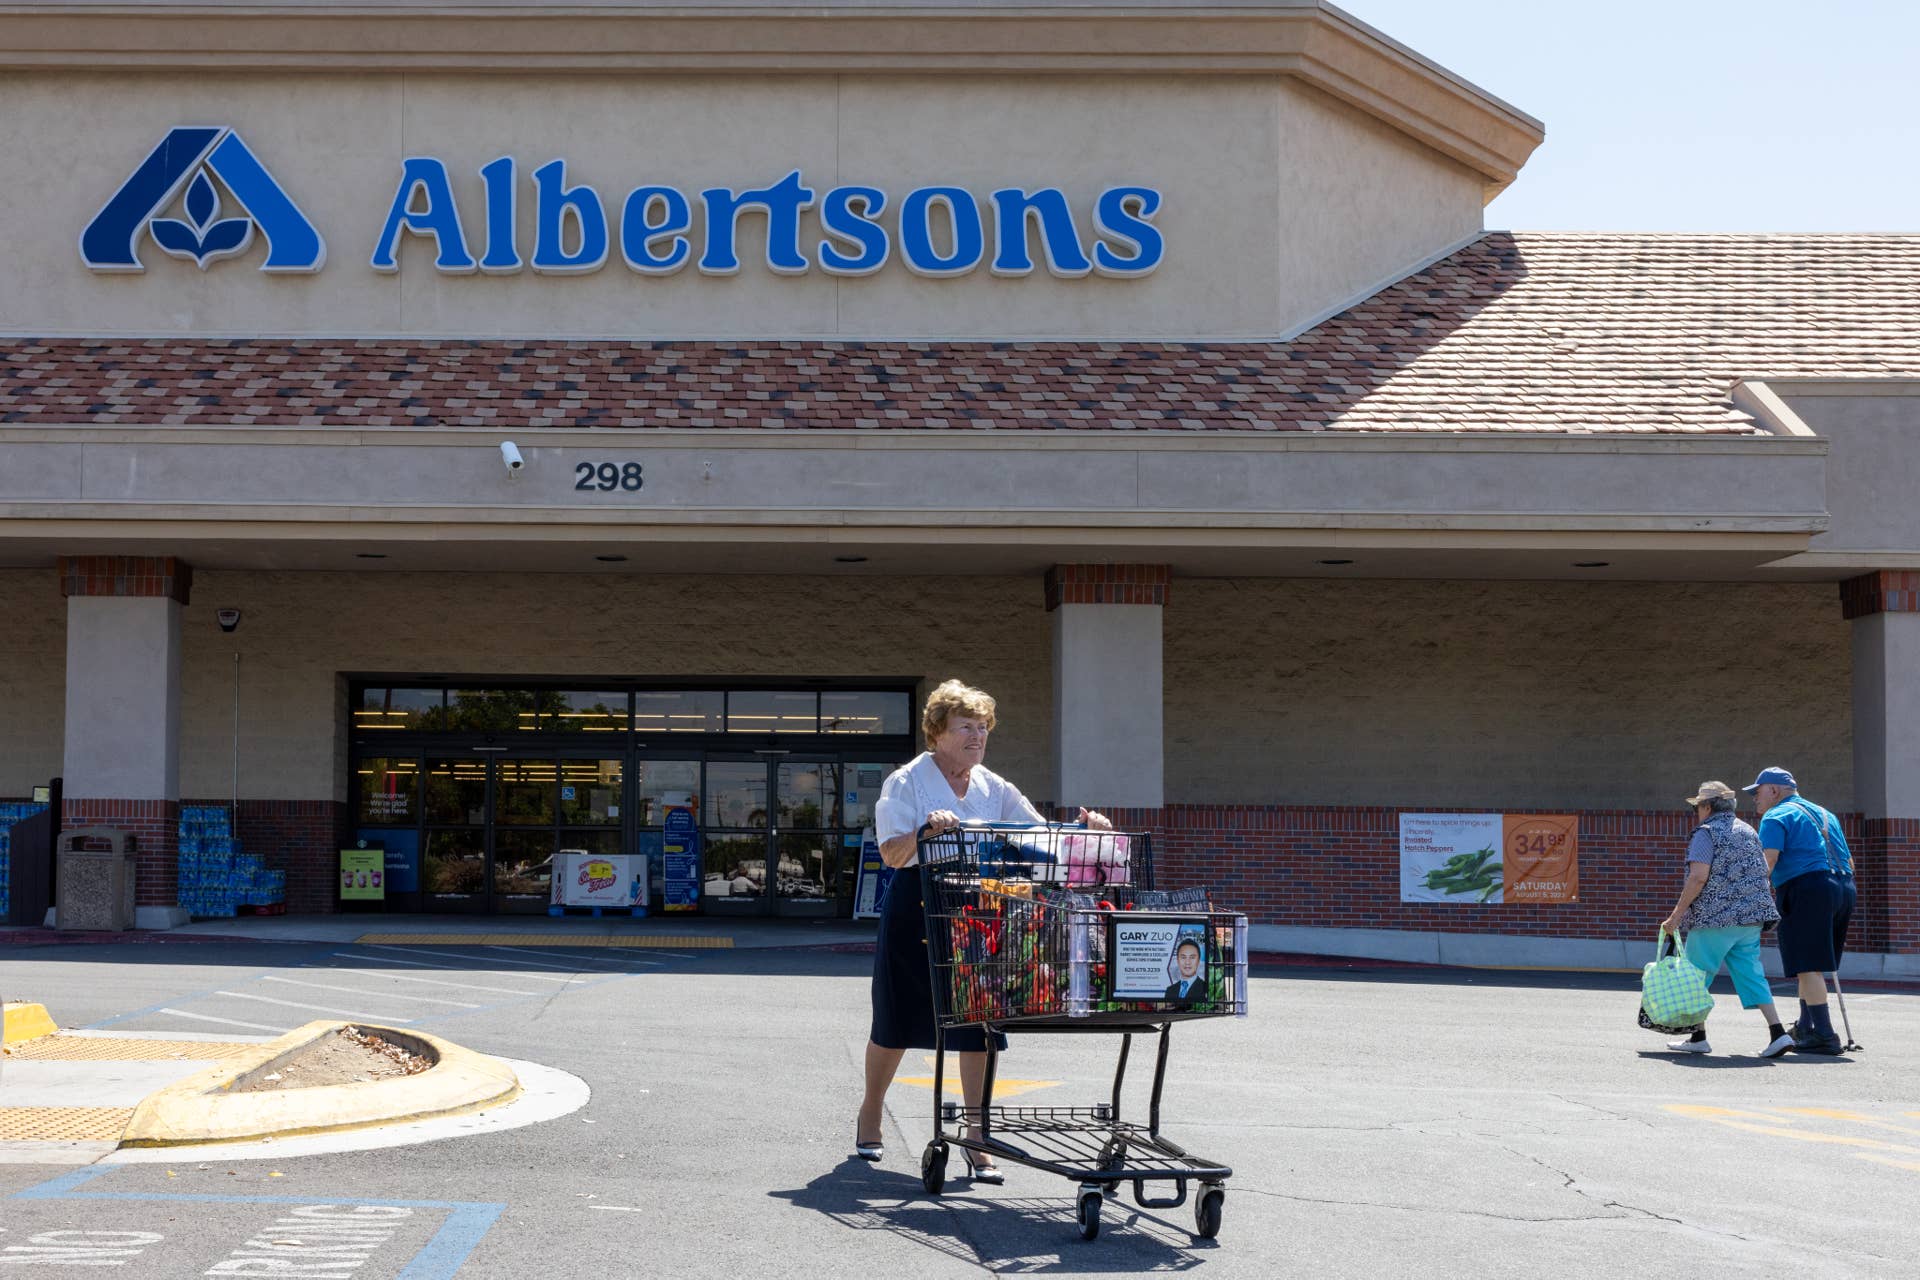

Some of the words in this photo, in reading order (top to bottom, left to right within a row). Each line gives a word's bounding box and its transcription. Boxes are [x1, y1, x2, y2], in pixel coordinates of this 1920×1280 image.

[369, 155, 1165, 277] Albertsons
[575, 462, 643, 491] 298
[1426, 846, 1454, 854] Peppers
[1512, 882, 1568, 891] SATURDAY
[1120, 932, 1149, 941] GARY
[1151, 932, 1173, 941] ZUO
